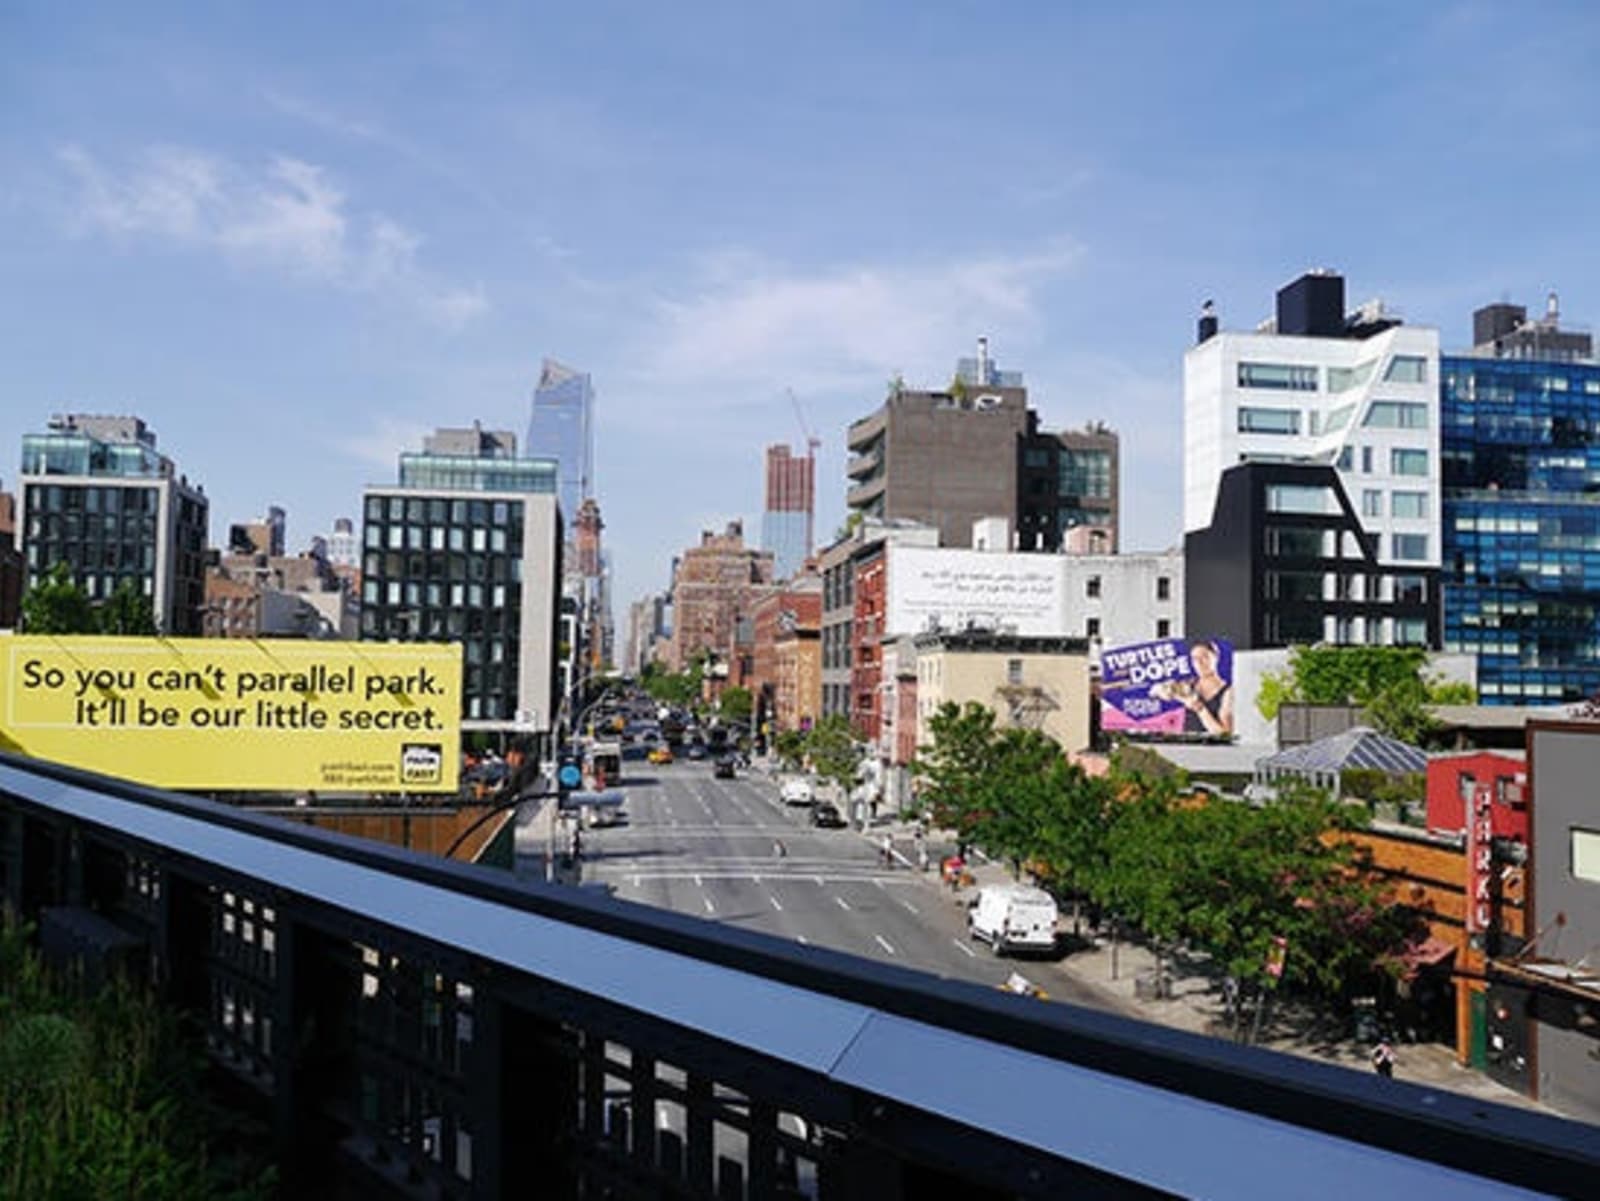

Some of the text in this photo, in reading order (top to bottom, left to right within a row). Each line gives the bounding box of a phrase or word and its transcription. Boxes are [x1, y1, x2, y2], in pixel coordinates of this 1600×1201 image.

[1105, 643, 1176, 669] TURTLES
[1130, 655, 1191, 684] DOPE
[23, 659, 445, 700] So you can't parallel park.
[76, 698, 444, 730] It'll be our little secret.
